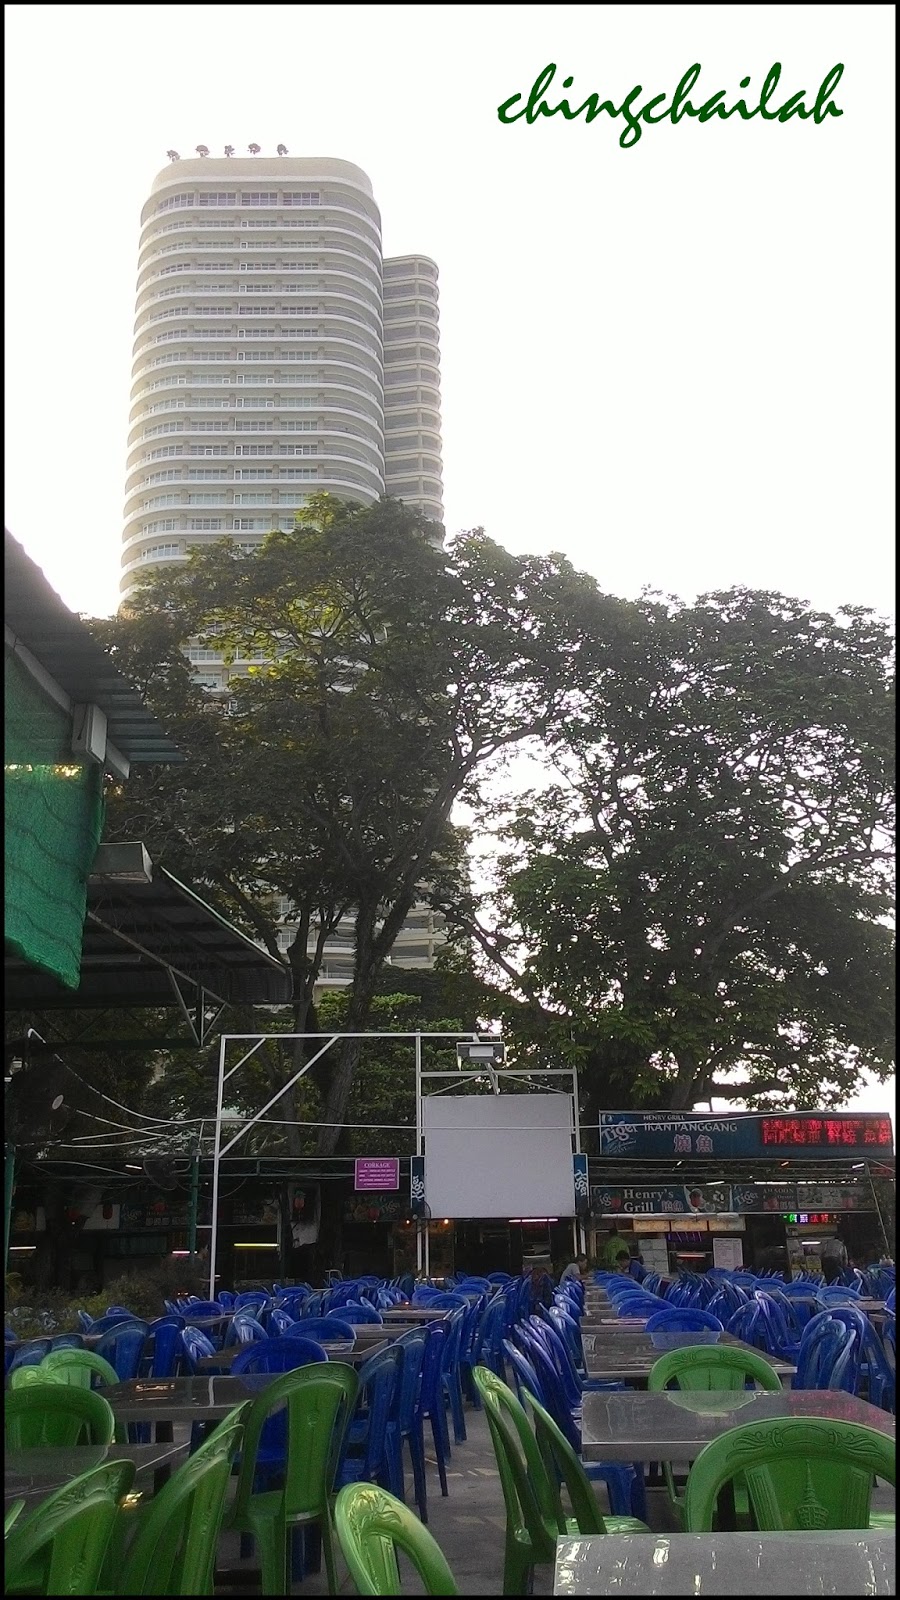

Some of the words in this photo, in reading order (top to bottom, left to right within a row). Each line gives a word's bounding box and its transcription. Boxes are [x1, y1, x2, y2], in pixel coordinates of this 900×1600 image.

[601, 1120, 638, 1143] Tiger
[643, 1122, 672, 1132] IKAN
[674, 1122, 738, 1132] PANGGANG
[412, 1174, 425, 1202] Tiger
[574, 1169, 588, 1197] Tiger
[623, 1188, 674, 1202] Henry's
[733, 1190, 759, 1205] Tiger
[623, 1201, 655, 1213] Grill
